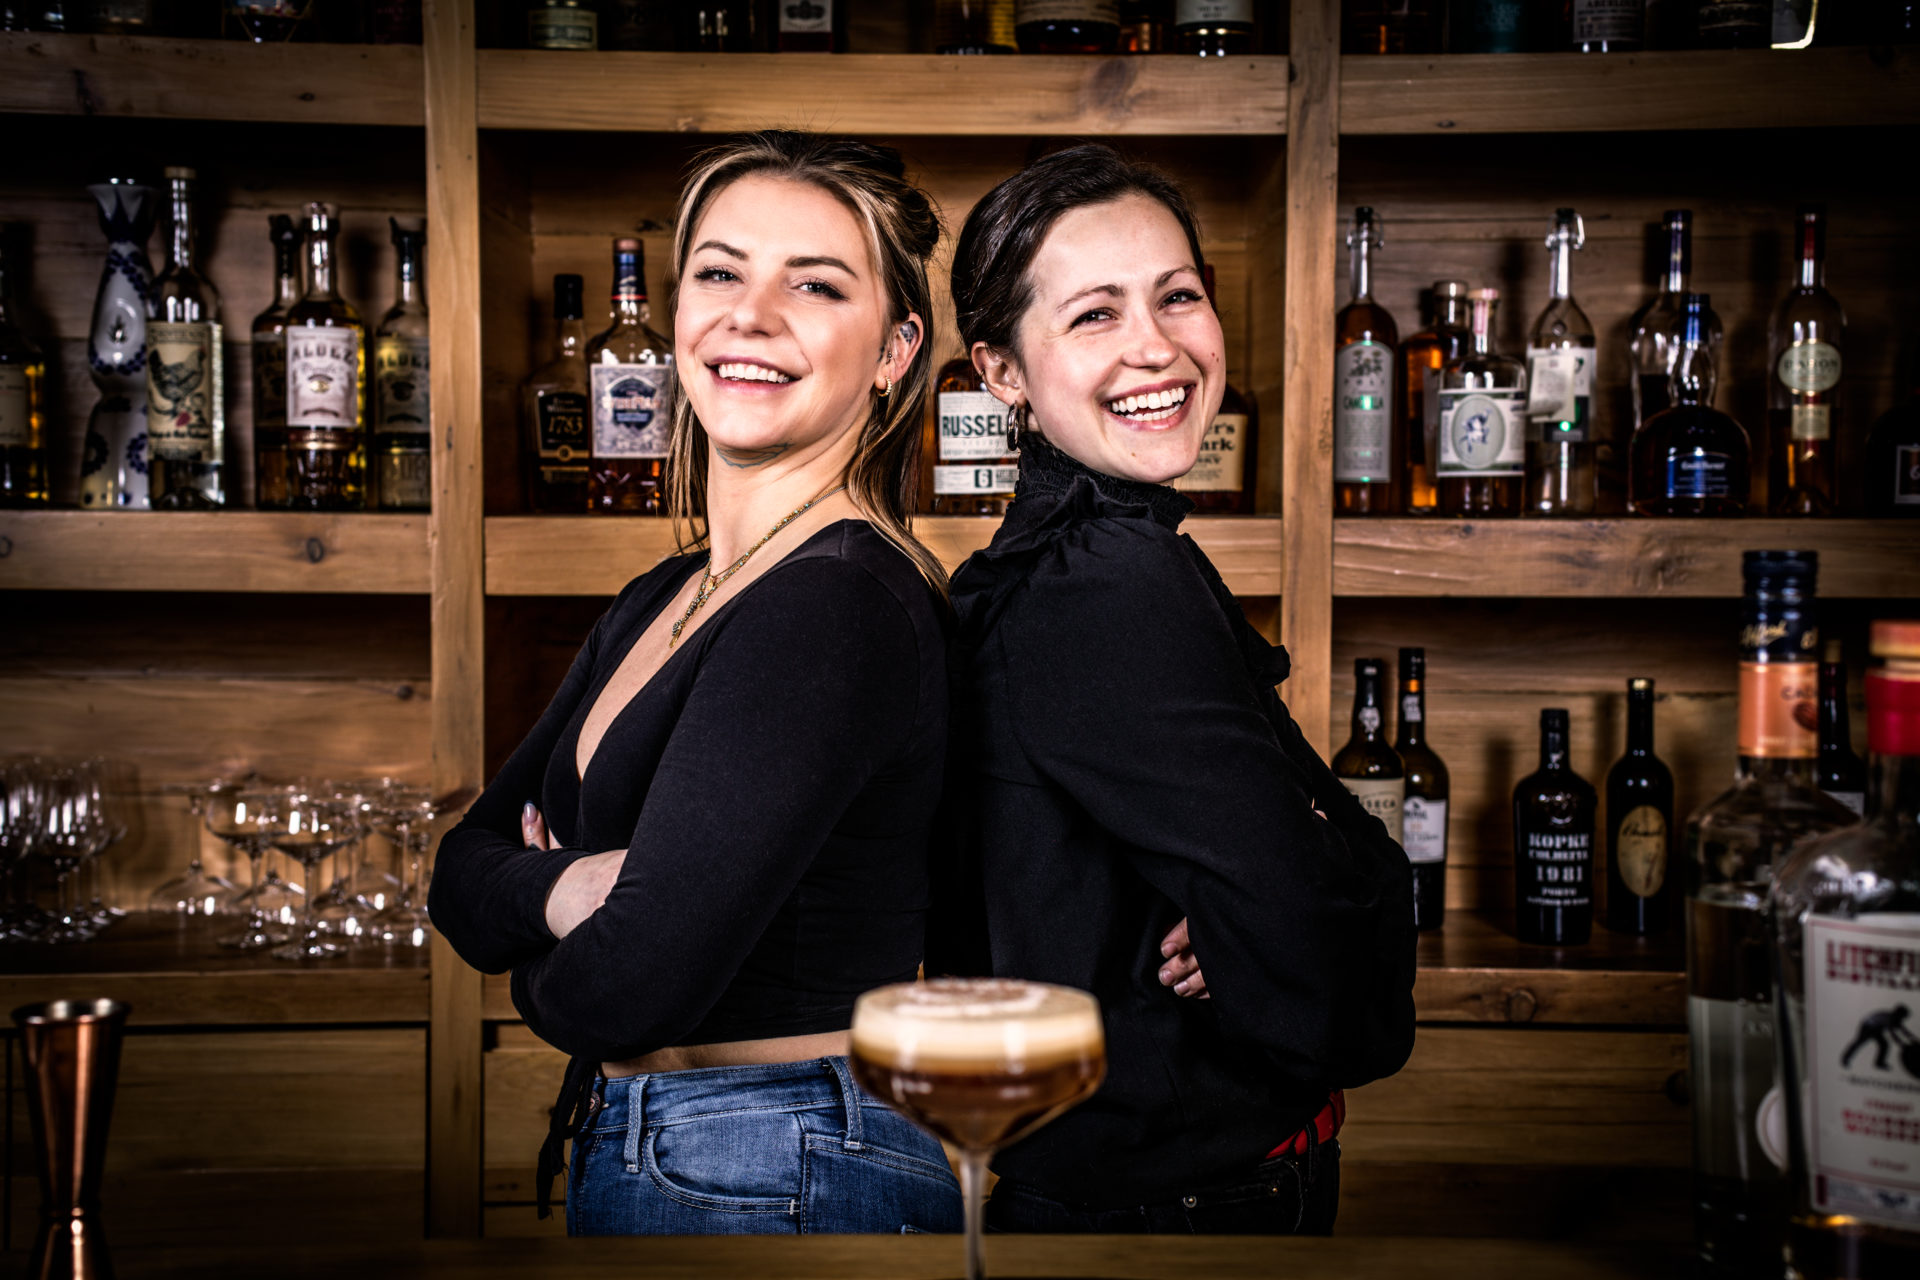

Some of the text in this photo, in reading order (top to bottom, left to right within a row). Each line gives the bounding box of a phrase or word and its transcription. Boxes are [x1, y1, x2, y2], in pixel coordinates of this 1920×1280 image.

[549, 415, 583, 435] 1783
[942, 414, 1009, 436] RUSSEL
[1201, 437, 1234, 451] ark
[1362, 799, 1397, 809] SECA
[1528, 832, 1590, 849] KOPKE
[1536, 865, 1583, 882] 1981
